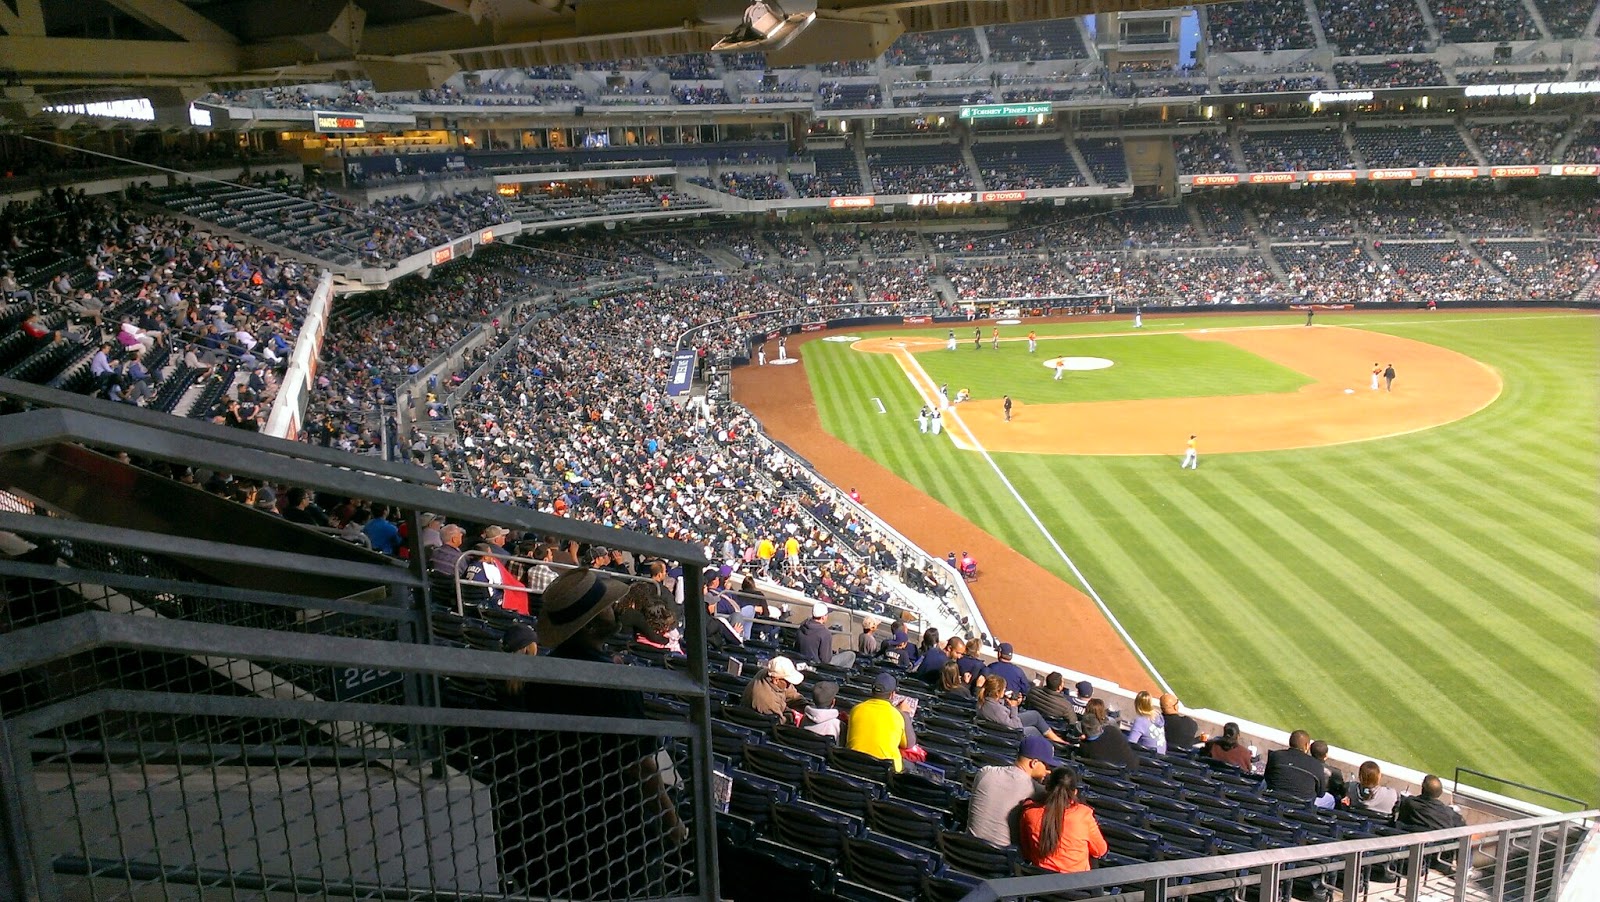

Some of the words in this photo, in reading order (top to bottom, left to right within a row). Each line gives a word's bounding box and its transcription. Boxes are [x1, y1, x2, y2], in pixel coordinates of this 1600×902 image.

[971, 108, 1002, 116] TORREY
[1003, 106, 1026, 115] PINES
[1027, 105, 1049, 113] BANK
[1384, 170, 1413, 178] TOYOTA
[1506, 167, 1535, 175] TOYOTA
